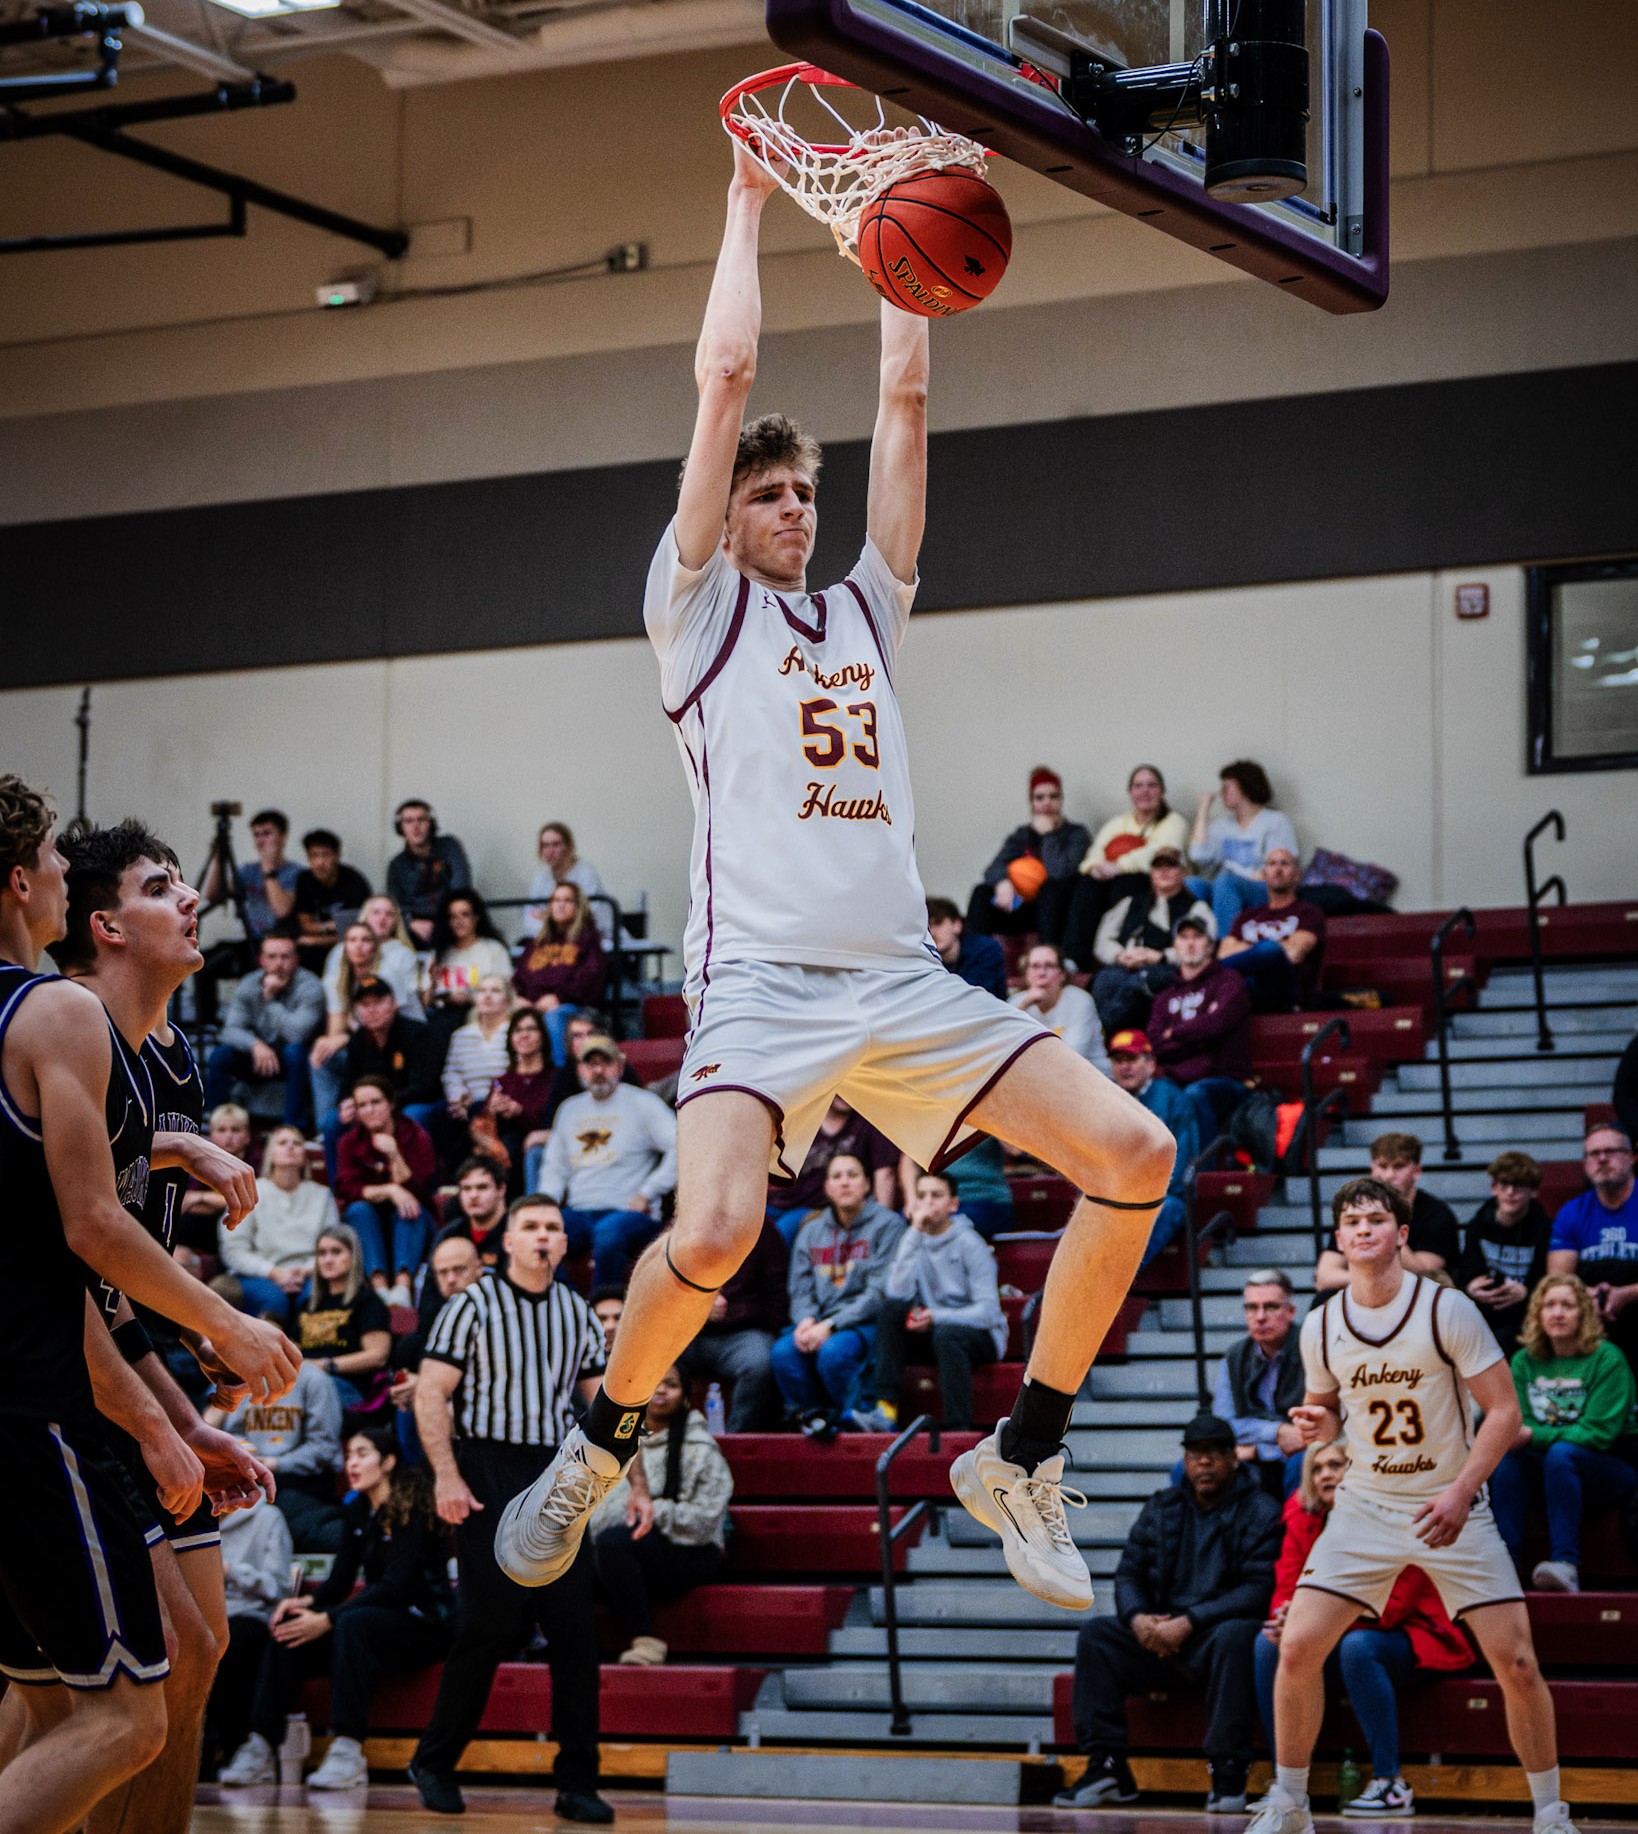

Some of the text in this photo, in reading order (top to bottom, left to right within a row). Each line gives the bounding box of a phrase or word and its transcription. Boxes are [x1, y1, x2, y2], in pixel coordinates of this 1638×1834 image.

[799, 697, 881, 770] 53
[1350, 1362, 1424, 1390] Ankeny
[1367, 1398, 1426, 1447] 23
[1372, 1454, 1438, 1475] Hawks
